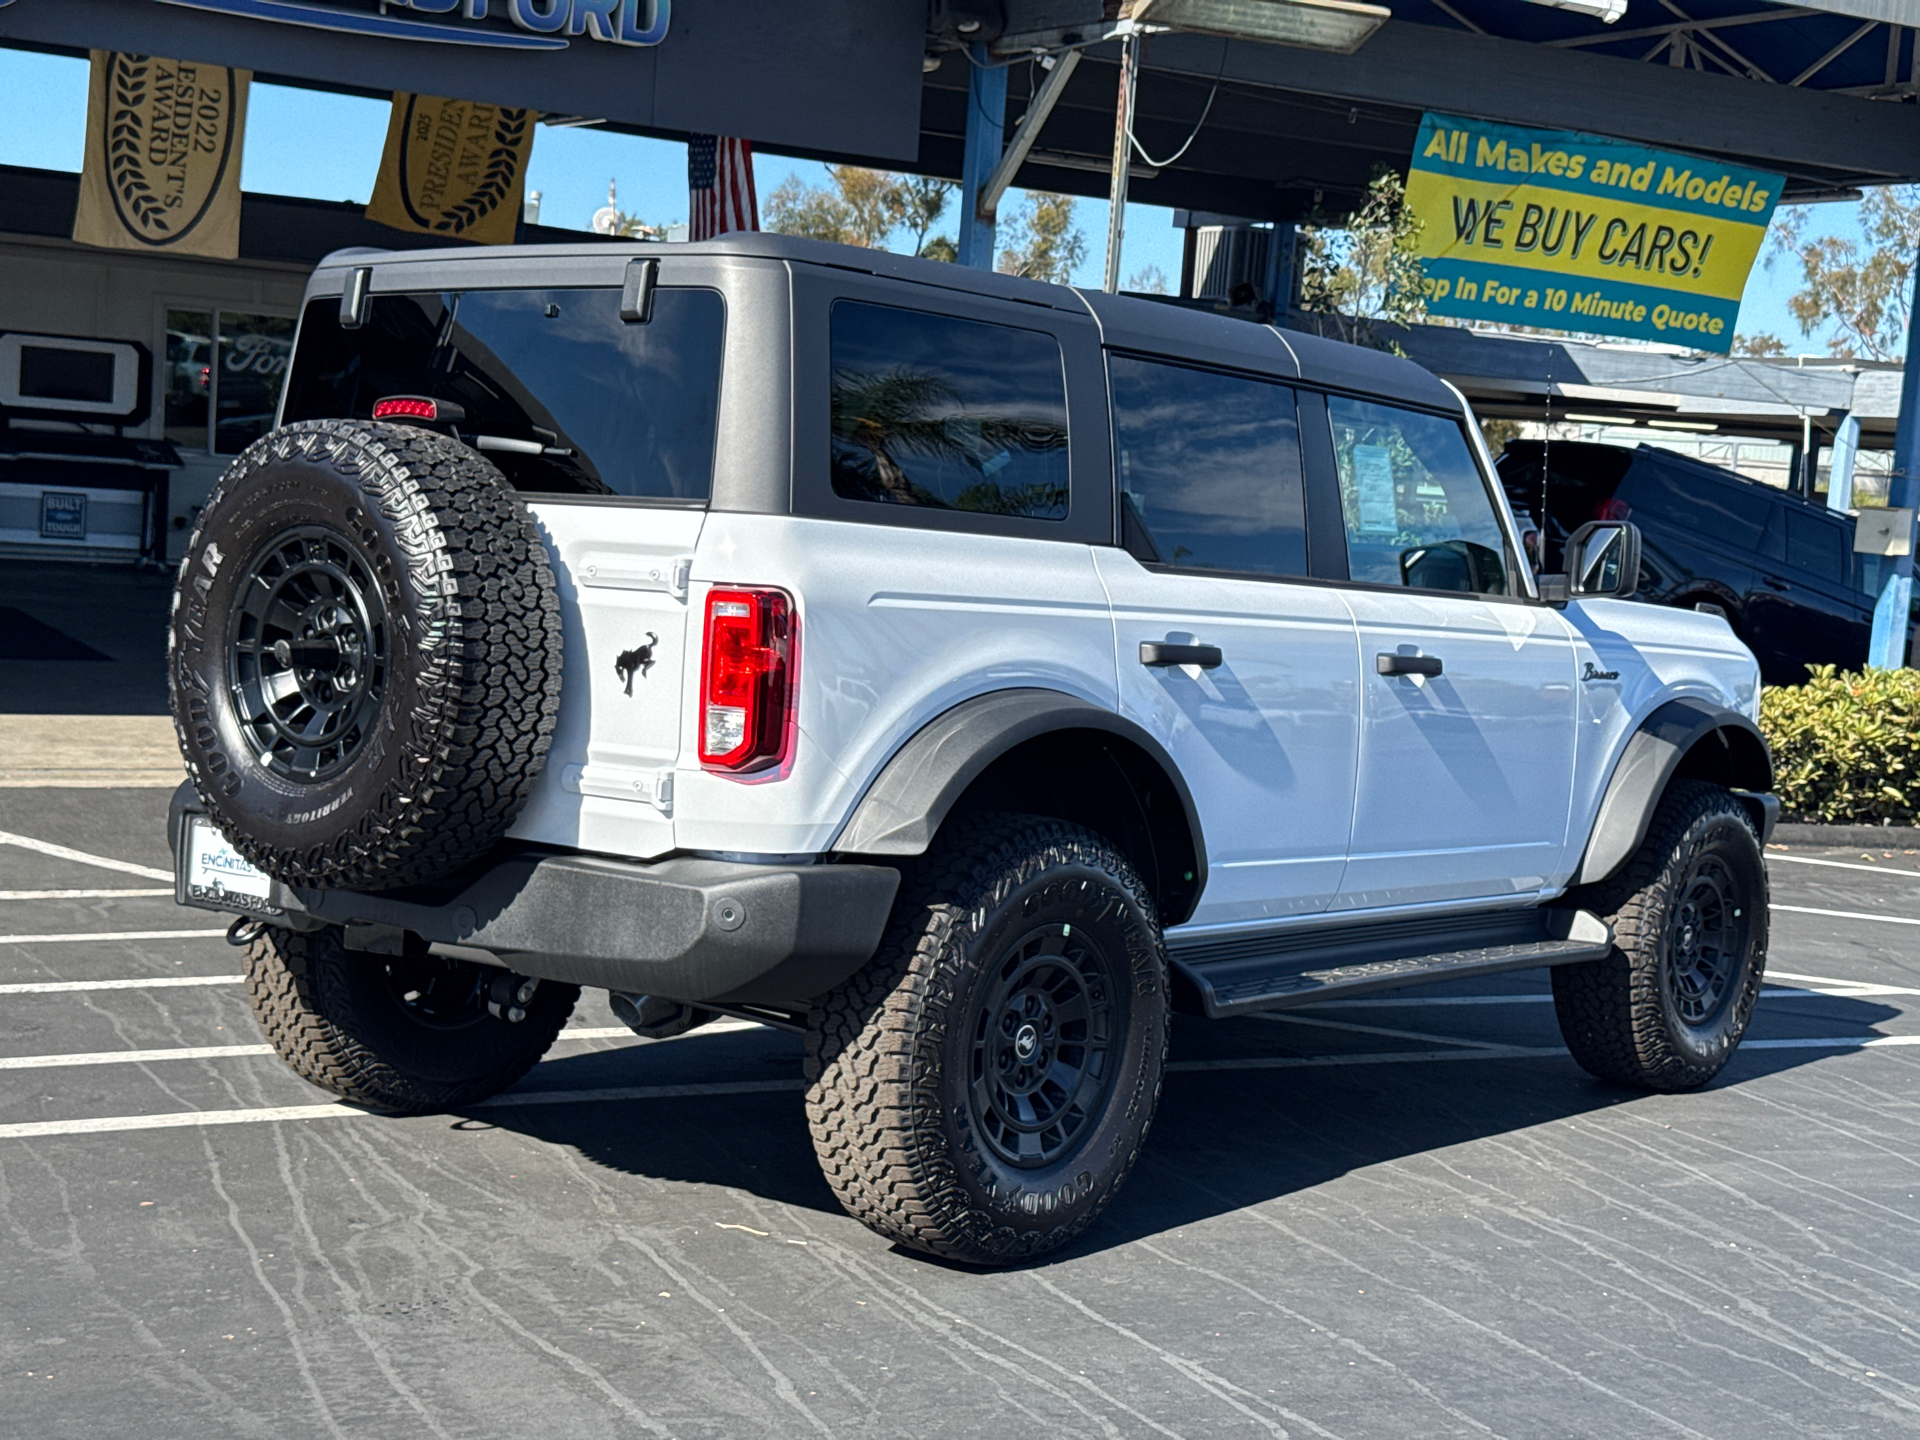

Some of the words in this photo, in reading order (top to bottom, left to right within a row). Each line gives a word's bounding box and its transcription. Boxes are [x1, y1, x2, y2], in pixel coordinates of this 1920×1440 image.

[463, 0, 672, 47] ORD
[150, 64, 176, 167] AWARD
[164, 61, 197, 209] ESIDENT'S
[193, 88, 221, 154] 2022
[1423, 128, 1469, 164] All
[1475, 136, 1587, 179] Makes
[1589, 159, 1656, 192] and
[1656, 166, 1769, 213] Models
[1452, 195, 1514, 248] WE
[1514, 203, 1598, 260] BUY
[1598, 217, 1714, 279] CARS!
[1455, 276, 1478, 301] In
[1482, 280, 1521, 306] For
[1524, 290, 1539, 309] a
[1543, 288, 1568, 312] 10
[1569, 291, 1647, 323] Minute
[1651, 304, 1724, 335] Quote
[226, 334, 292, 374] For
[47, 497, 82, 510] BUILT
[284, 787, 354, 824] TERRITORY
[201, 853, 253, 873] ENCINITAS
